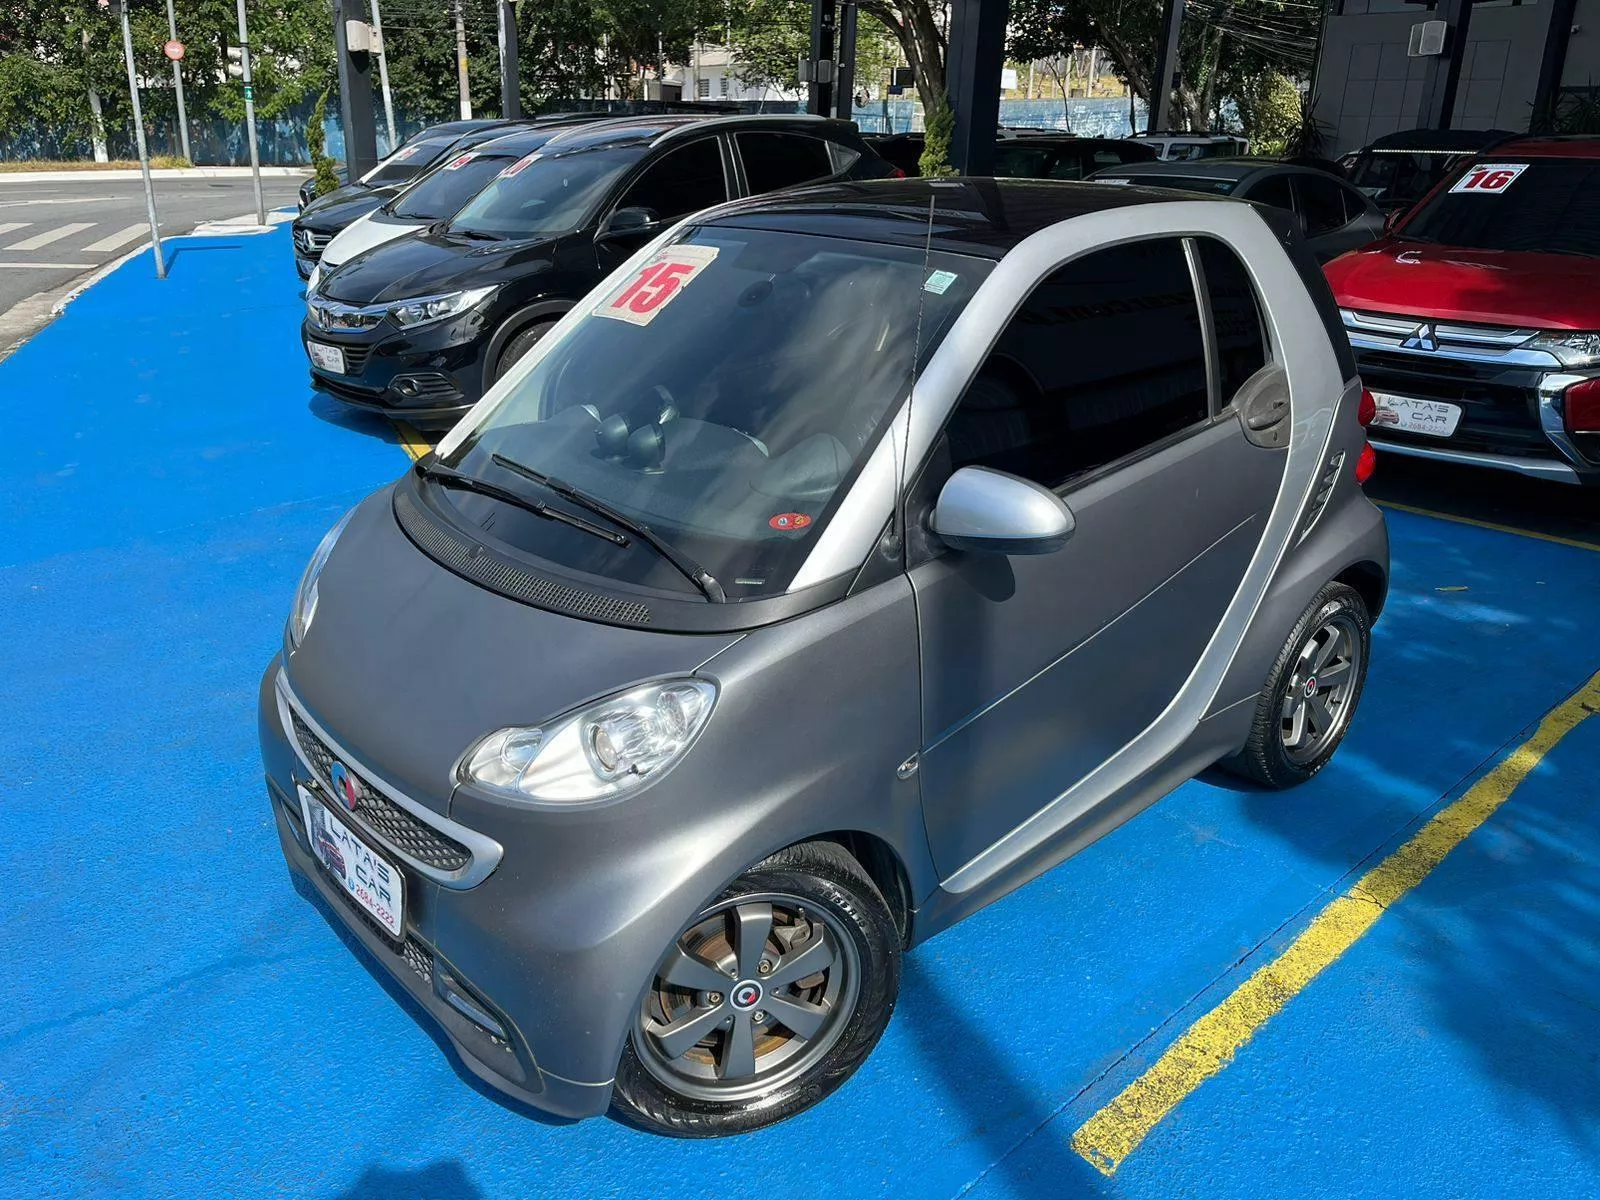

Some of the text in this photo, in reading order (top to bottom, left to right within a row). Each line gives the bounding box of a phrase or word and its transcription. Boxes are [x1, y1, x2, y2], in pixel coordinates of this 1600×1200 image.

[1464, 171, 1514, 190] 16
[611, 262, 695, 313] 15
[1411, 412, 1447, 424] CAR
[330, 816, 390, 884] LATA'S
[356, 863, 392, 909] CAR
